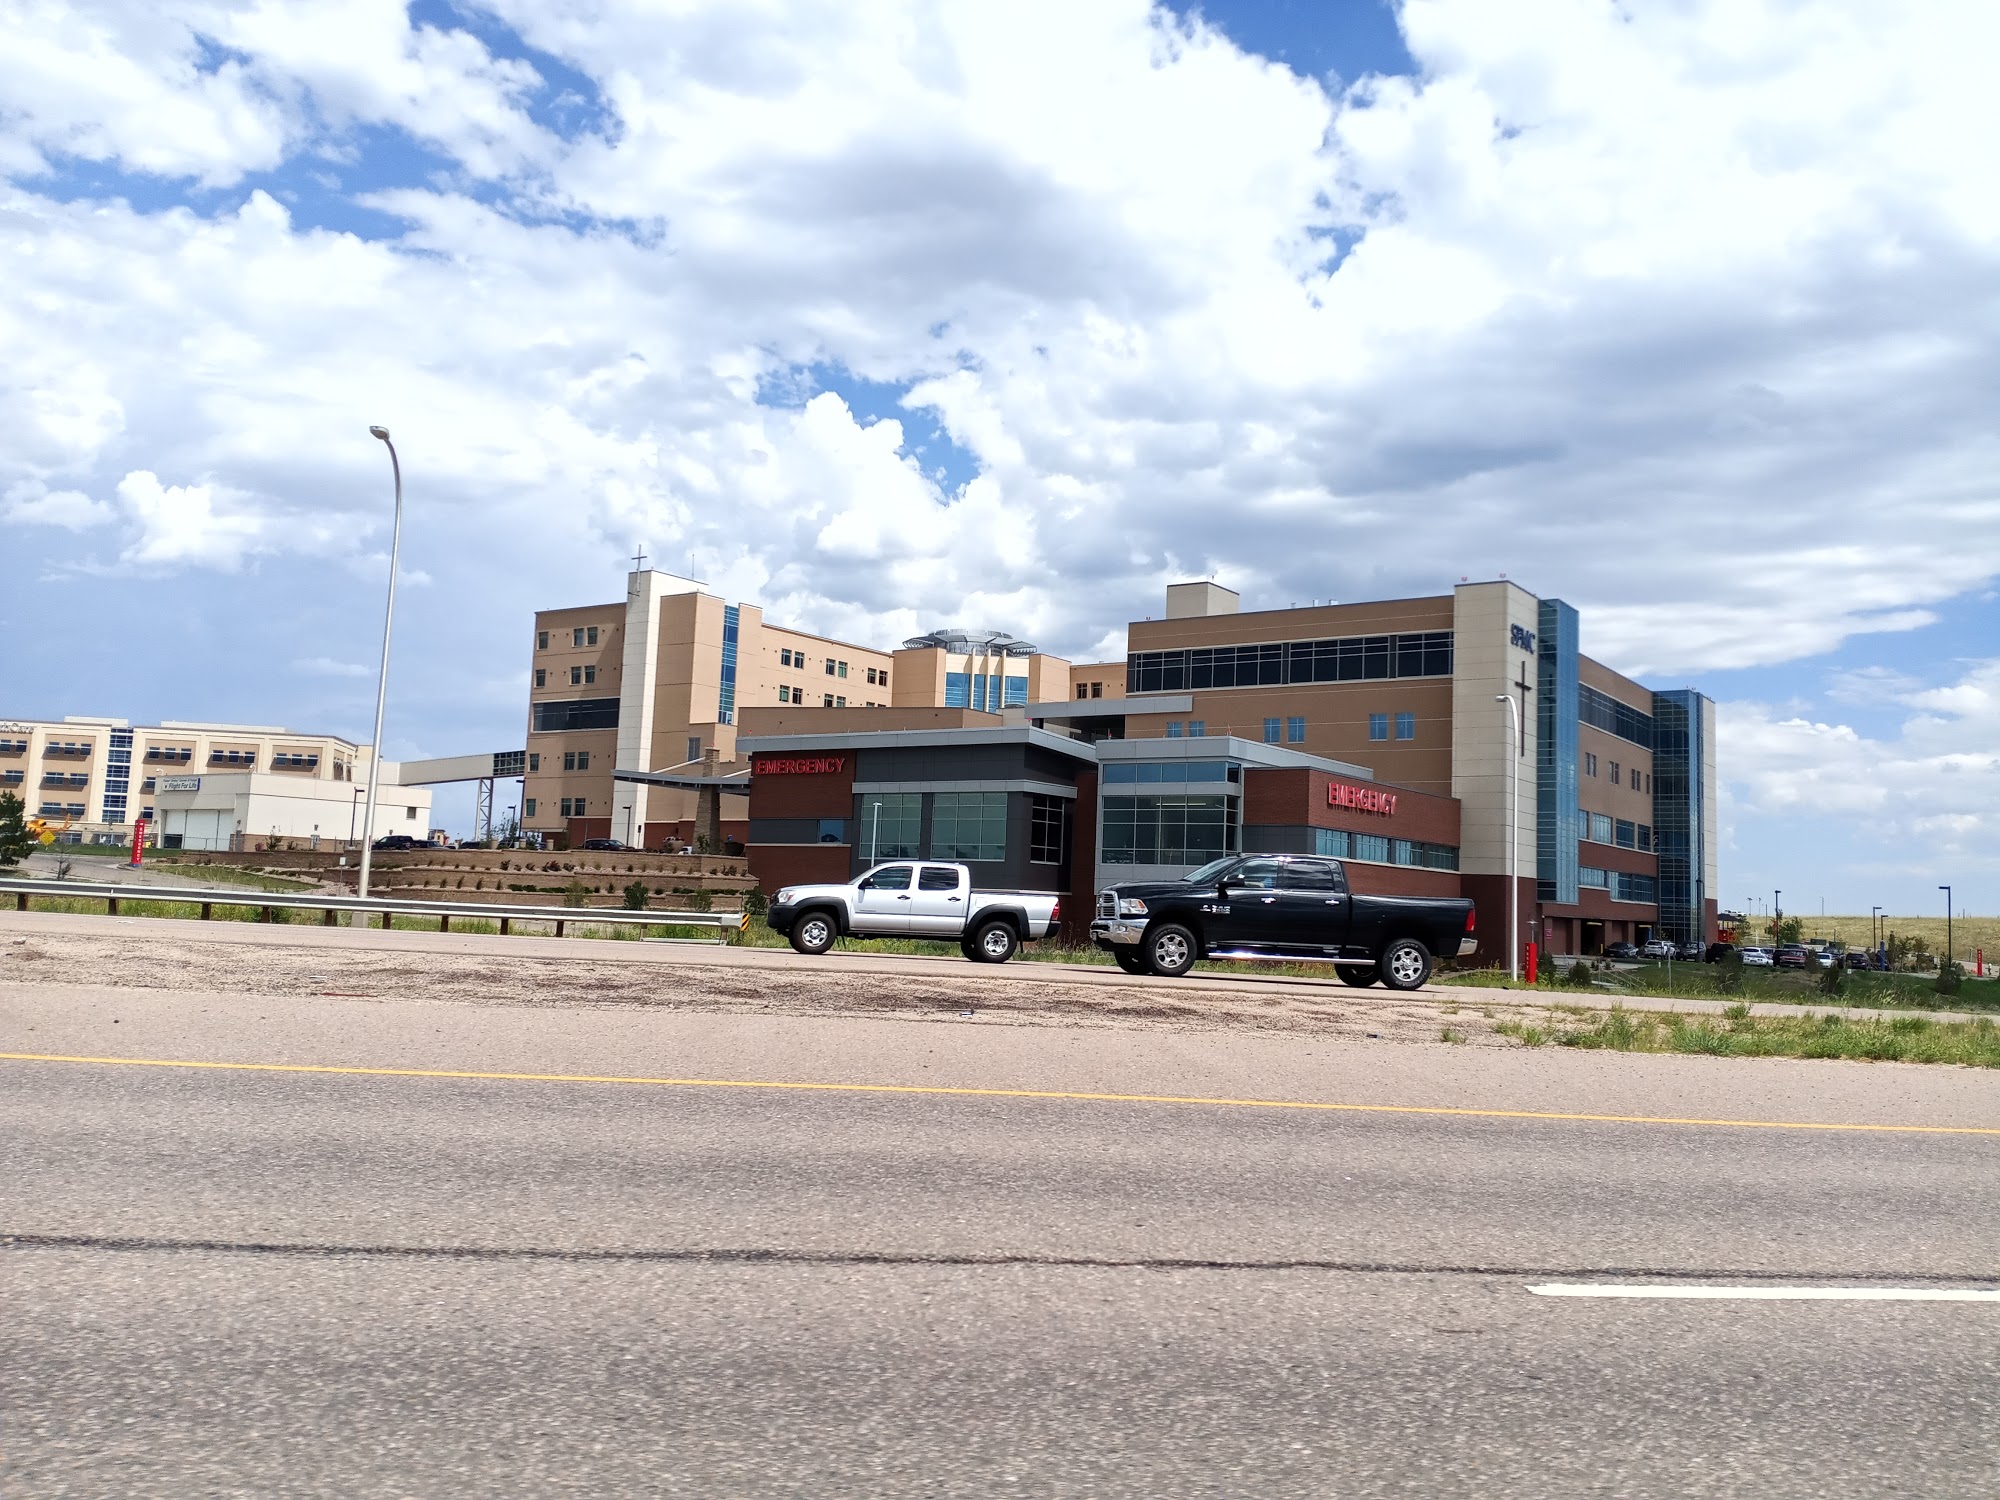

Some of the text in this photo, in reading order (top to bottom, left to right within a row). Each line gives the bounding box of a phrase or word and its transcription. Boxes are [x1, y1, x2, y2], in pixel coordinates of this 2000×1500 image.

[1510, 623, 1536, 655] SFMC
[756, 758, 845, 774] EMERGENCY
[169, 782, 181, 790] Flight
[1328, 782, 1397, 814] EMERGENCY
[136, 827, 144, 861] EMERGENCY
